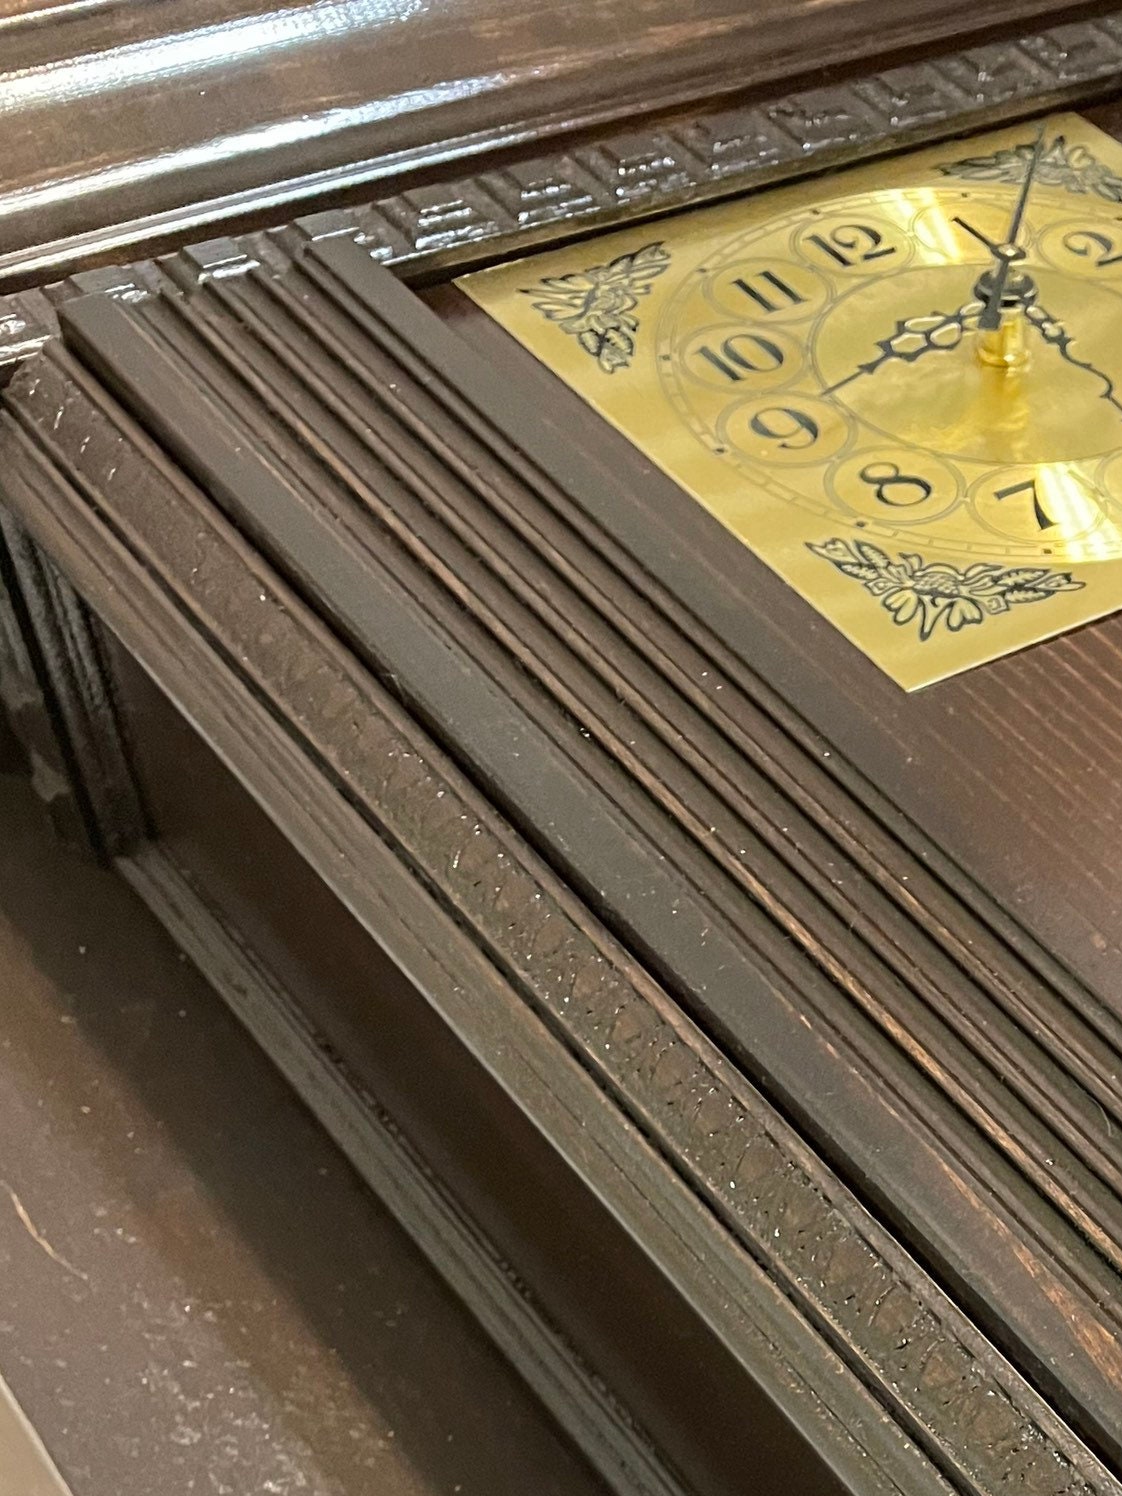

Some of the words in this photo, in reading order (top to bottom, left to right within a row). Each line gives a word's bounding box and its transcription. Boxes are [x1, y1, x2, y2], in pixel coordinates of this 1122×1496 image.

[805, 223, 896, 267] 12
[731, 270, 805, 312] 11
[697, 334, 784, 381] 10
[749, 407, 819, 449] 9
[859, 461, 931, 506] 8
[993, 478, 1057, 530] 7
